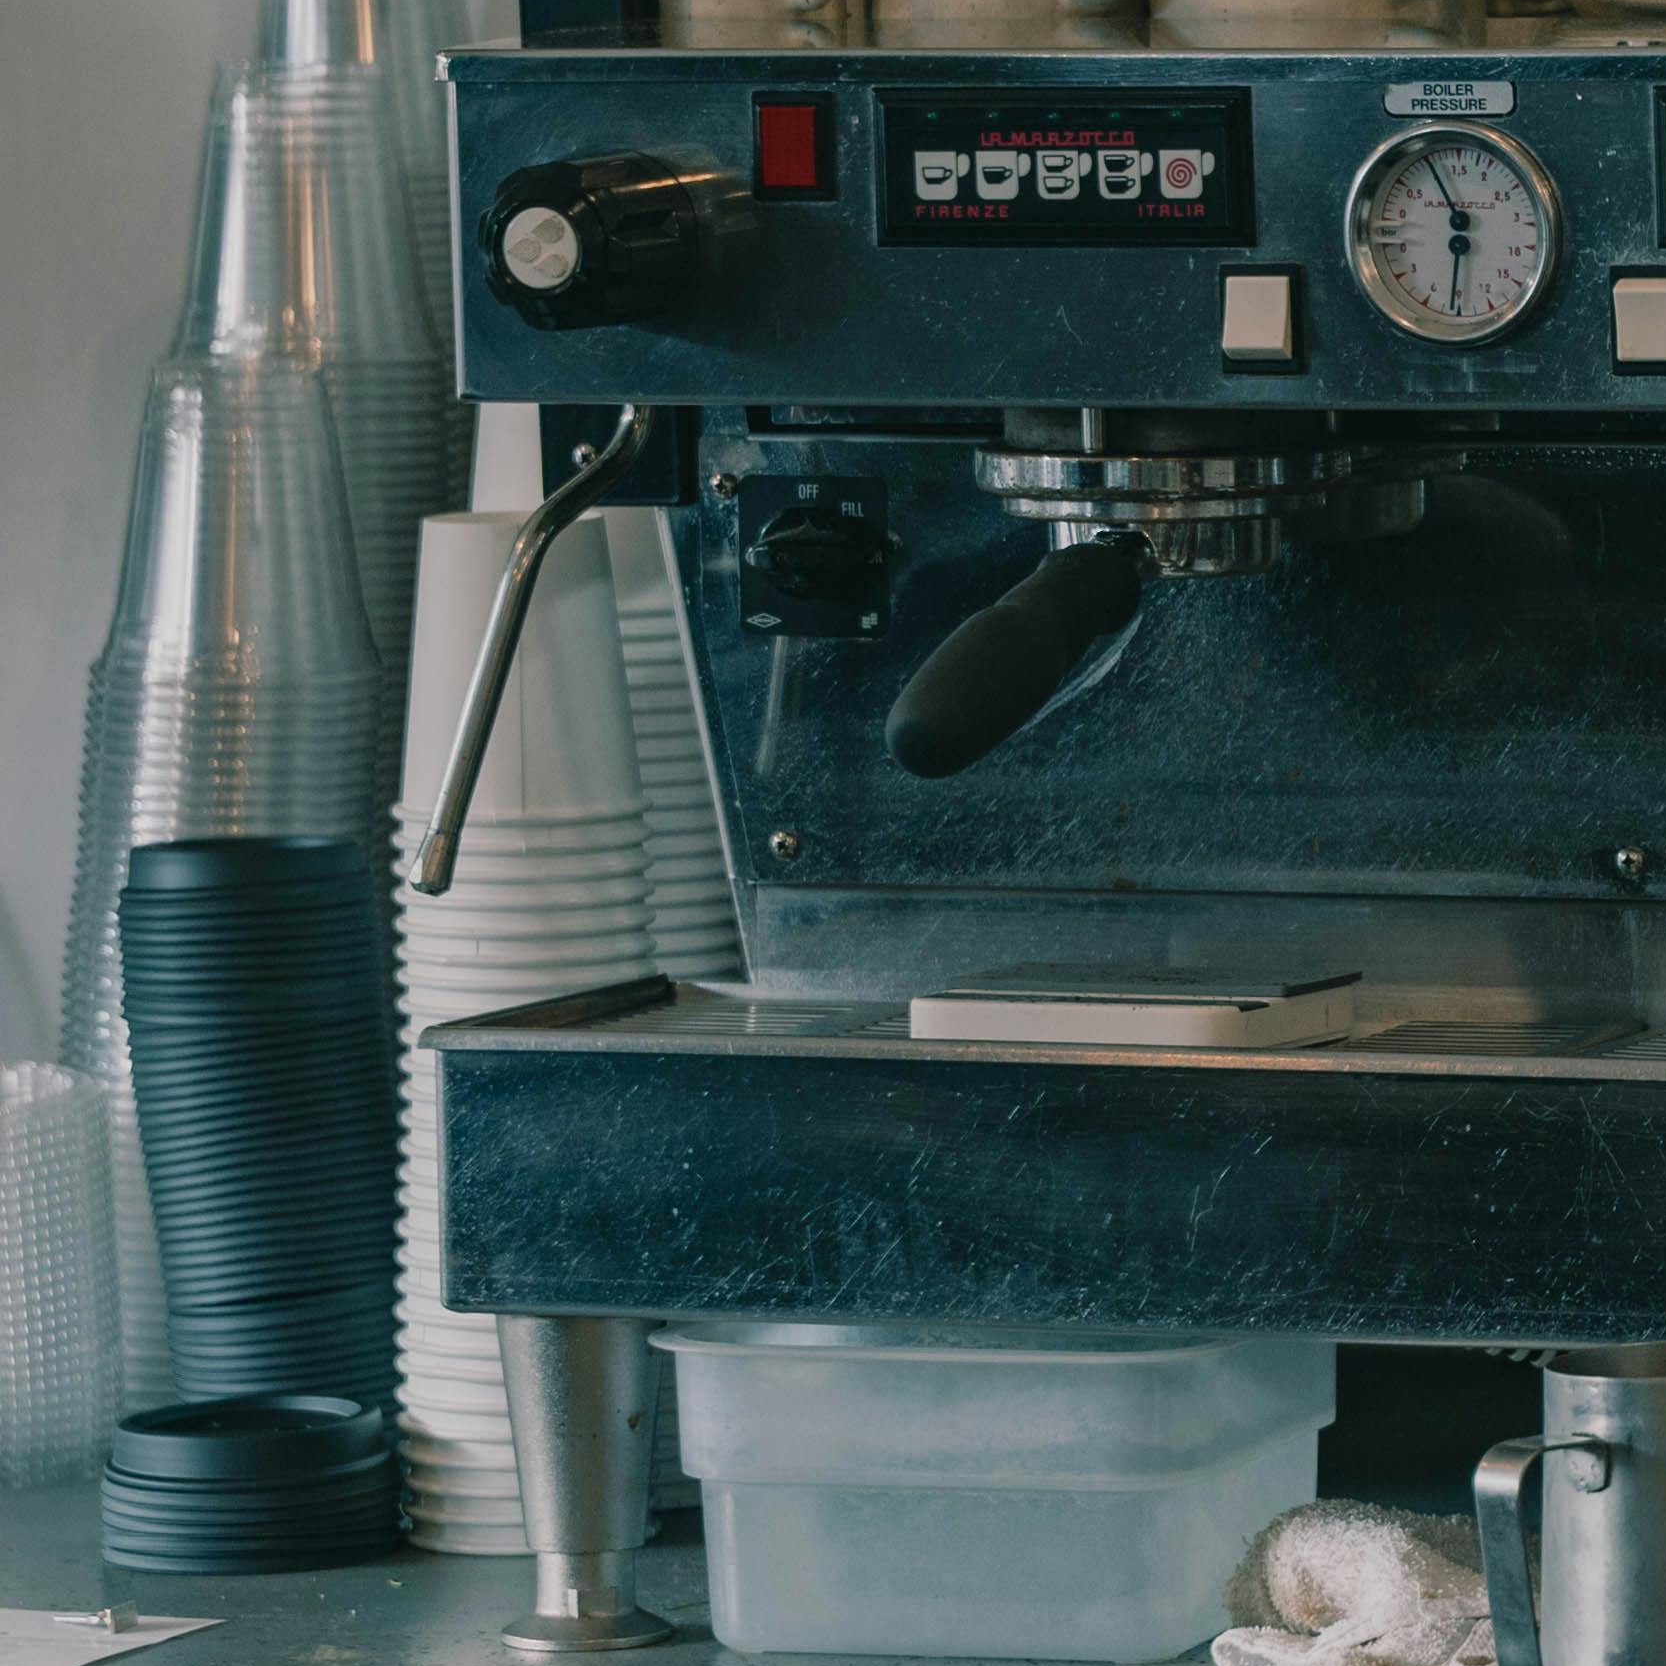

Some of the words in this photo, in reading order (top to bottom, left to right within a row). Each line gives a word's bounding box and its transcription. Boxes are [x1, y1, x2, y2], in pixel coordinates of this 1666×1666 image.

[1423, 84, 1474, 96] BOILER
[1411, 98, 1487, 111] PRESSURE
[980, 130, 1001, 147] LA
[1010, 130, 1136, 147] MARZOCCO
[1452, 164, 1468, 177] 1,5
[1481, 171, 1488, 182] 2
[1406, 189, 1423, 201] 0,5
[1494, 191, 1511, 203] 2,5
[914, 204, 1009, 219] FIRENZE
[1137, 204, 1205, 219] ITALIA
[1399, 209, 1407, 219] 0
[1513, 212, 1520, 222] 3
[1400, 243, 1407, 253] 0
[1497, 268, 1510, 279] 15
[798, 484, 820, 500] OFF
[841, 501, 865, 518] FILL
